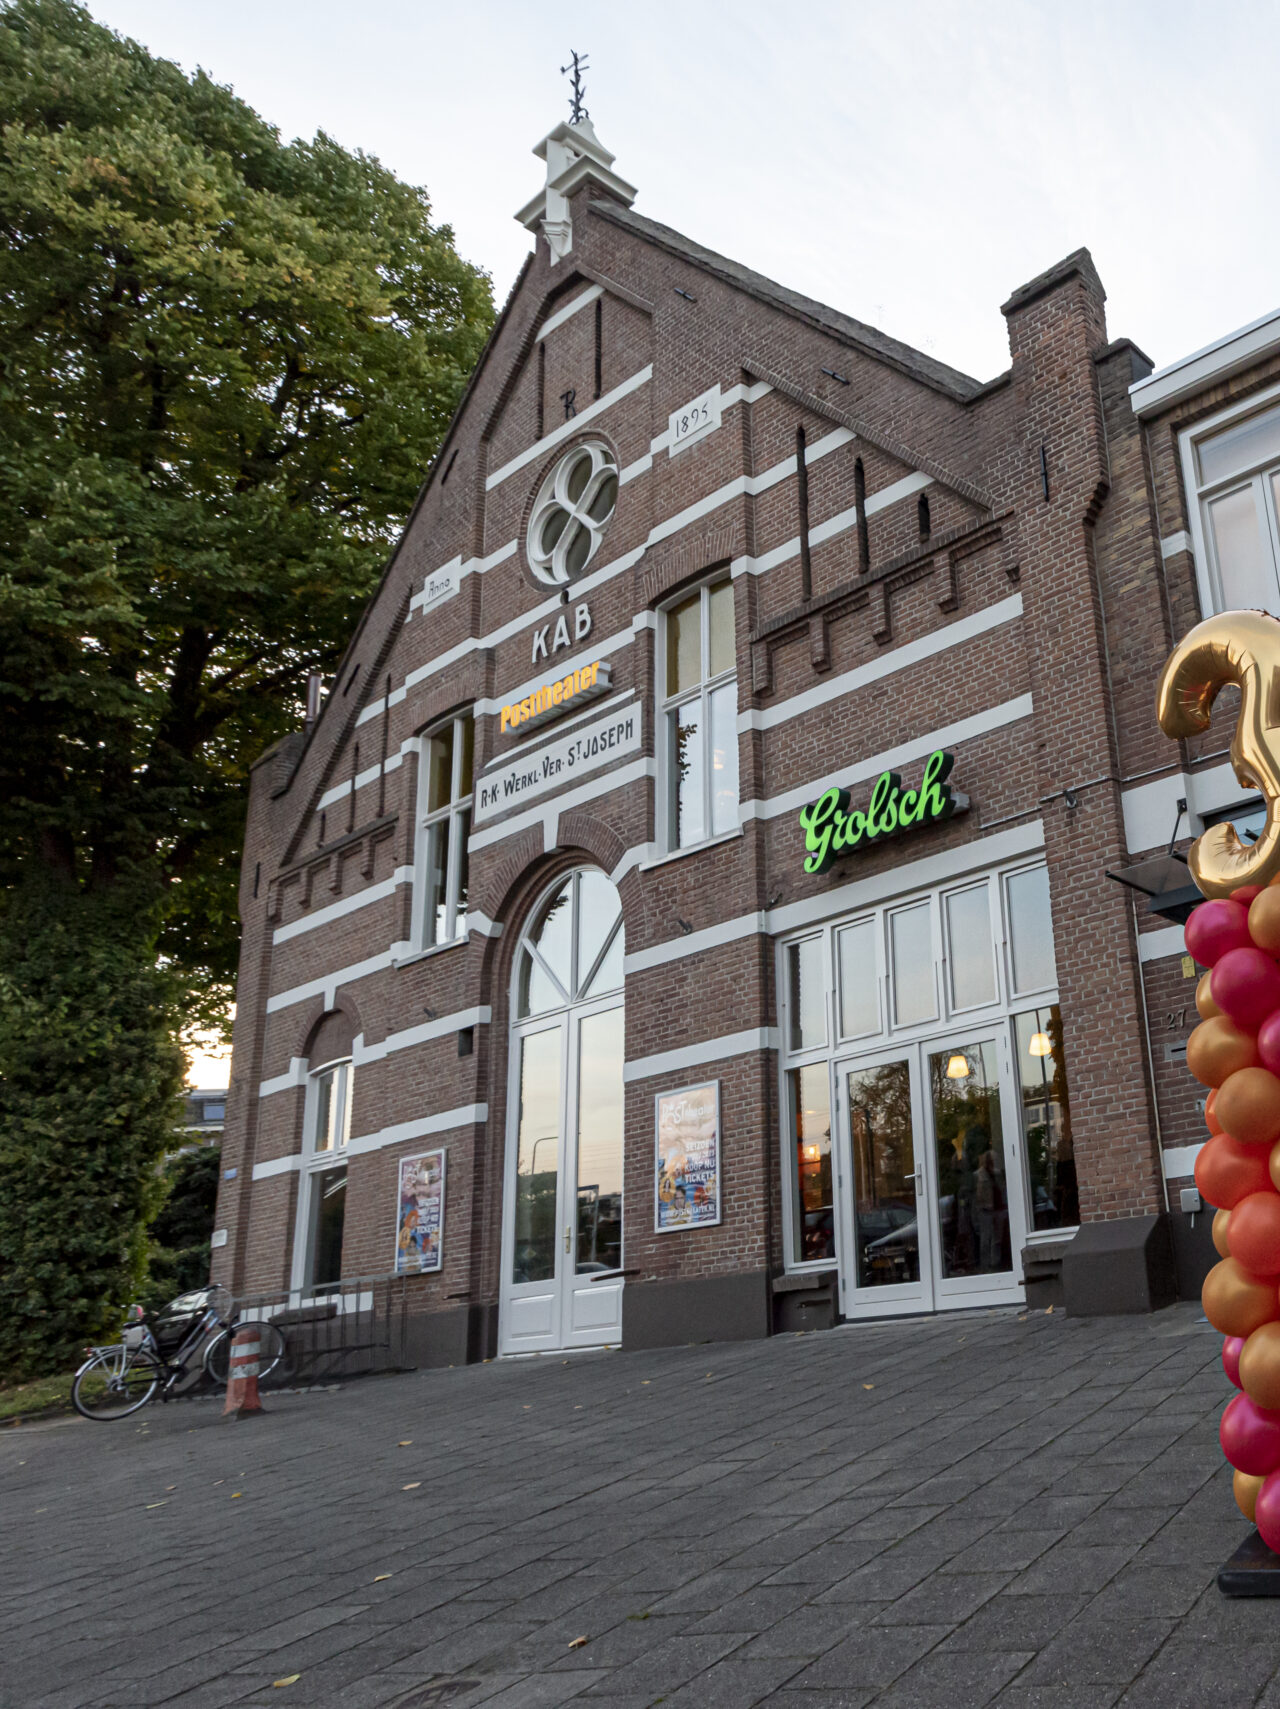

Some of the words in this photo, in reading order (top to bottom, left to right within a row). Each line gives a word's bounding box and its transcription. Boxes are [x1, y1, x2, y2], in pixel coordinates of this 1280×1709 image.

[676, 401, 708, 438] 1895
[531, 603, 592, 664] KAB
[500, 660, 600, 733] Posttheater
[800, 750, 946, 873] Grolsch
[1167, 1009, 1186, 1030] 27
[684, 1170, 715, 1183] TICKETS
[704, 1159, 715, 1169] NU
